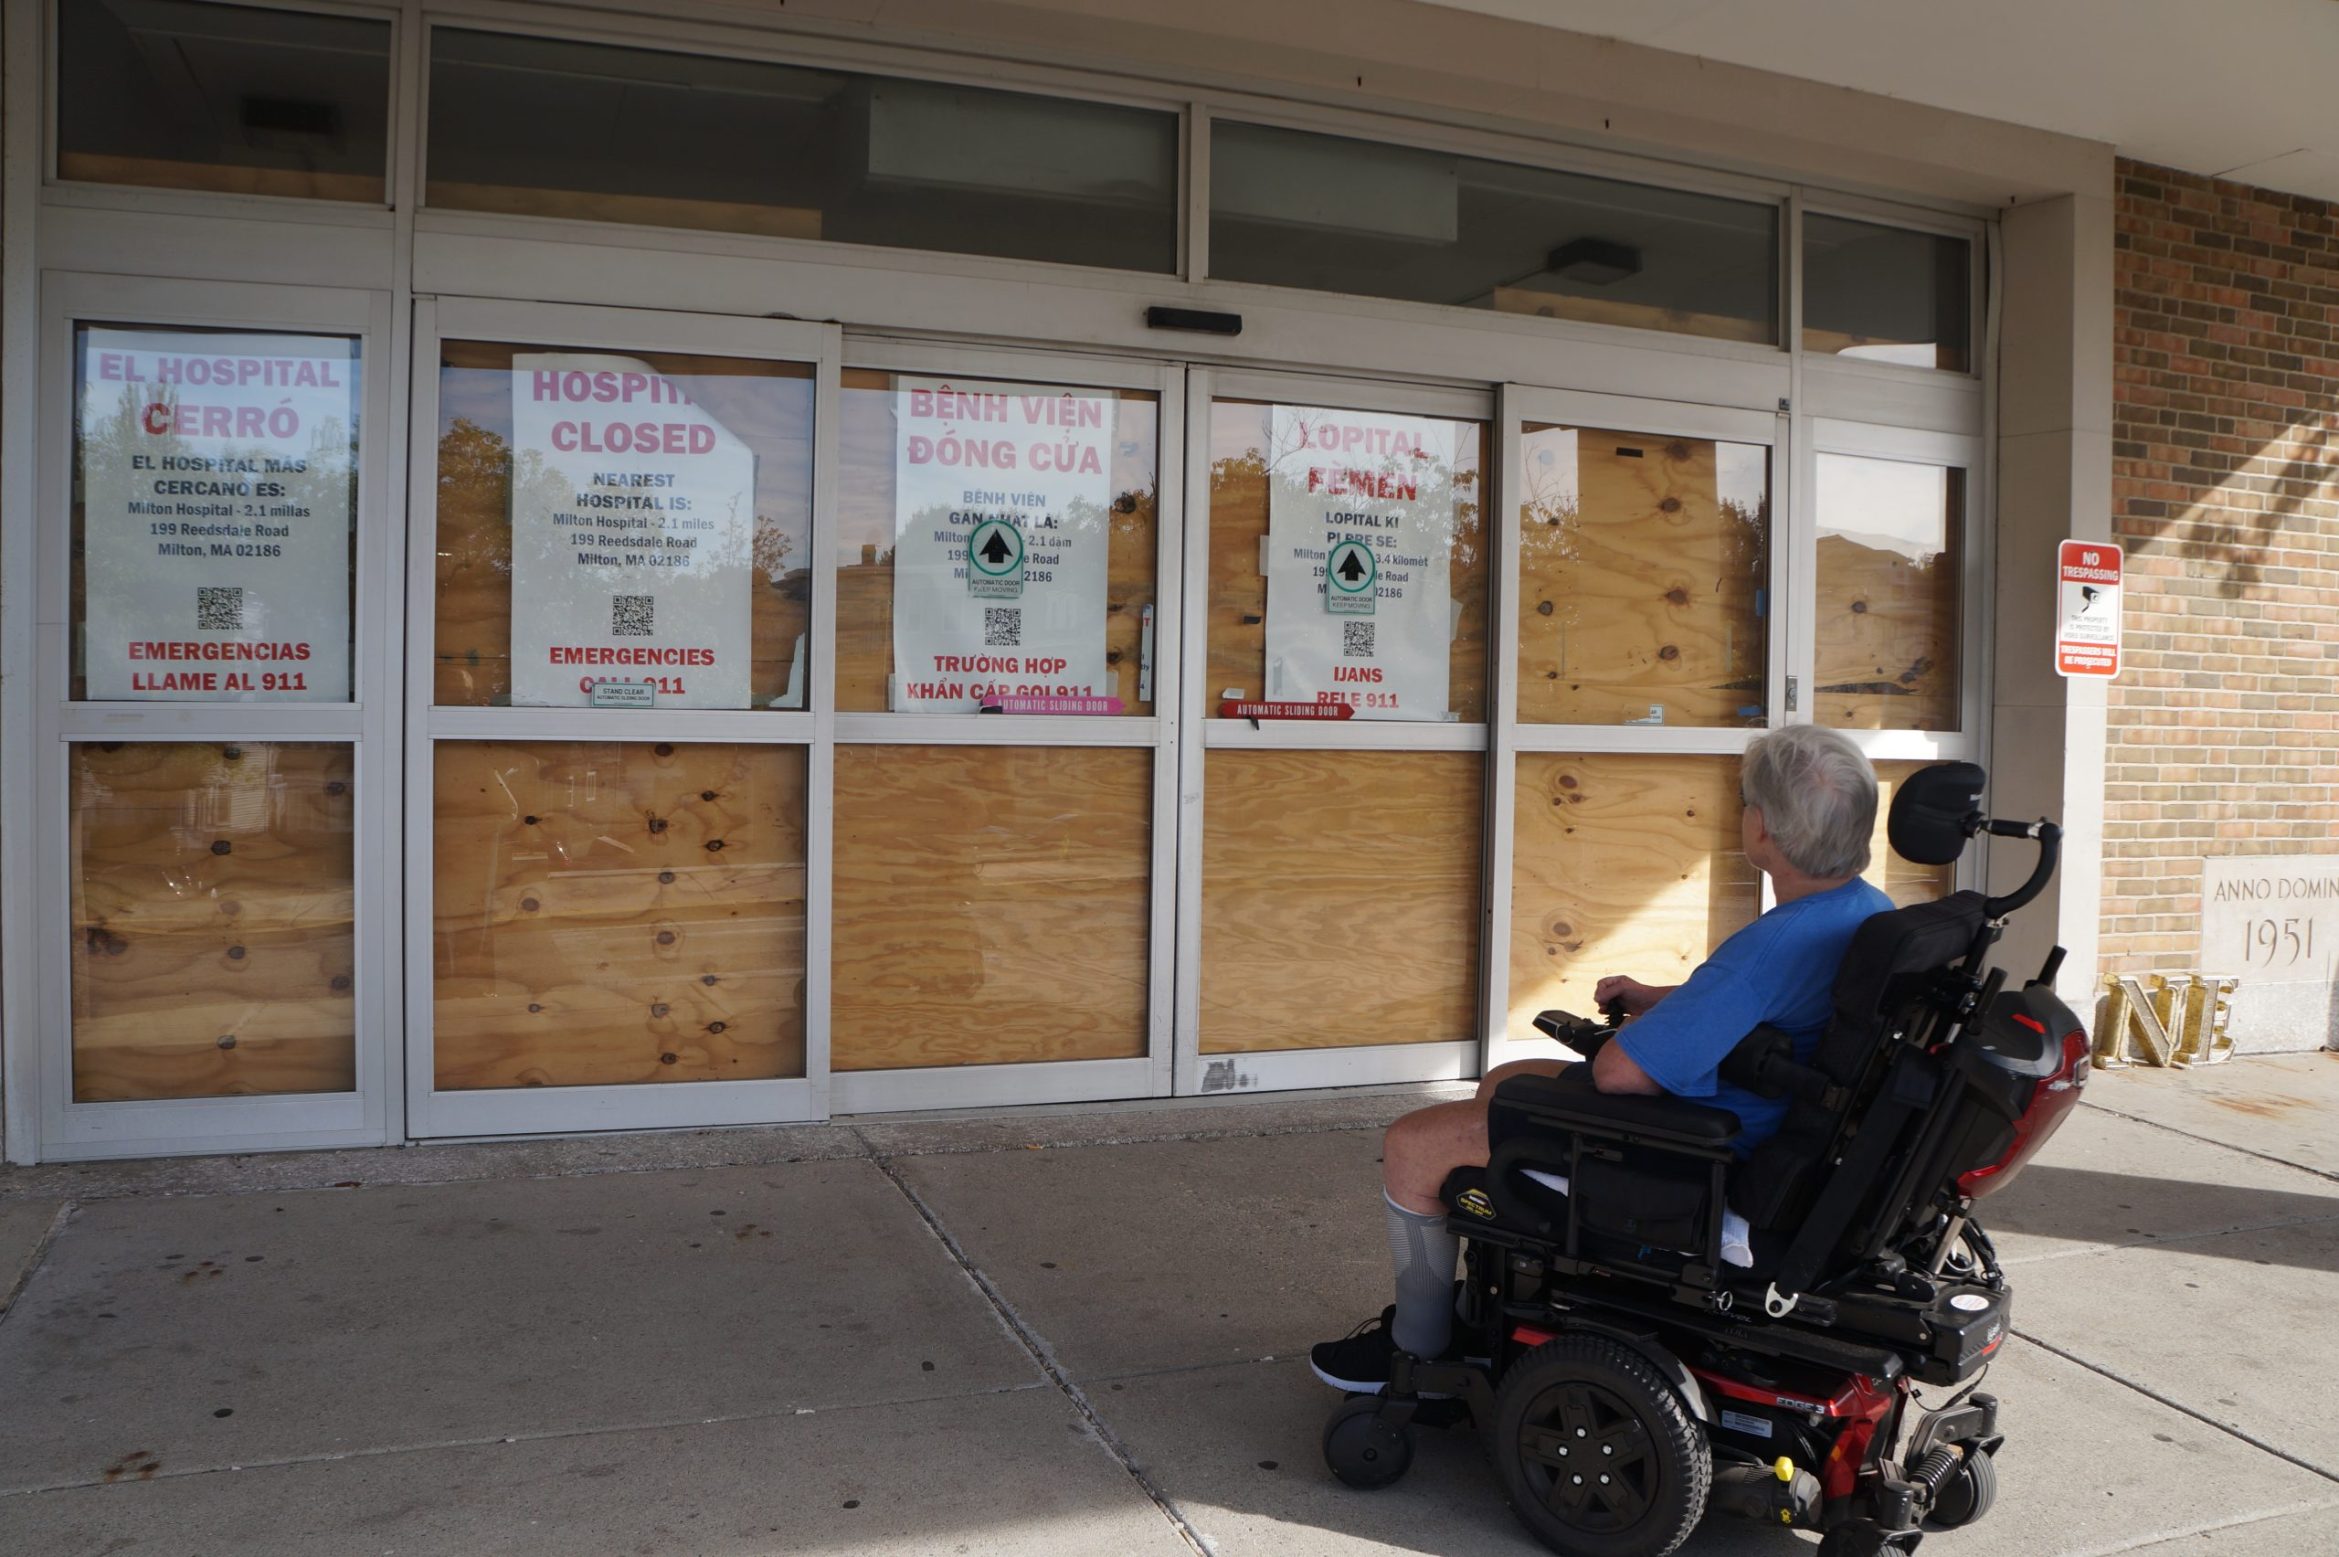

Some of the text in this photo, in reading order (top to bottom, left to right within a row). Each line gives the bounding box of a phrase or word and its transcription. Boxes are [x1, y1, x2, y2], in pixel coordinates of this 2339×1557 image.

[100, 353, 340, 387] EL HOSPITAL
[911, 384, 1102, 434] BỆNH VIỆN
[142, 398, 299, 439] CERRÓ
[551, 421, 716, 455] CLOSED
[1299, 421, 1429, 459] LOPITAL
[907, 429, 1017, 470] ĐÓNG
[132, 455, 156, 470] EL
[162, 456, 259, 473] HOSPITAL
[594, 473, 675, 487] NEAREST
[154, 480, 286, 497] CERCANO ES:
[128, 502, 172, 515] Milton
[176, 503, 233, 518] Hospital
[245, 505, 266, 517] 2.1
[270, 505, 310, 517] millas
[576, 494, 692, 510] HOSPITAL IS:
[553, 513, 593, 527] Milton
[596, 516, 647, 531] Hospital
[658, 517, 678, 529] 2.1
[682, 518, 714, 530] miles
[1326, 512, 1399, 528] LOPITAL KI
[151, 523, 289, 537] 199 Reedsdale Road
[571, 534, 697, 548] 199 Reedsdale Road
[1028, 535, 1046, 547] 2.1
[1376, 535, 1397, 548] SE:
[158, 543, 281, 558] Milton, MA 02186
[1294, 548, 1325, 560] Milton
[1376, 554, 1391, 564] 3.4
[2082, 551, 2100, 566] NO
[578, 553, 690, 567] Milton, MA 02186
[1032, 553, 1059, 565] Road
[1386, 571, 1409, 582] Road
[2063, 566, 2119, 581] TRESPASSING
[129, 642, 311, 661] EMERGENCIAS
[550, 647, 715, 666] EMERGENCIES
[132, 673, 308, 691] LLAME AL 911
[1334, 666, 1383, 683] IJANS
[1050, 701, 1082, 711] SLIDING
[1086, 702, 1109, 712] DOOR
[1367, 693, 1399, 708] 911
[1237, 704, 1338, 716] AUTOMATIC SLIDING DOOR
[2214, 879, 2272, 901] ANNO
[2245, 918, 2313, 968] 1951
